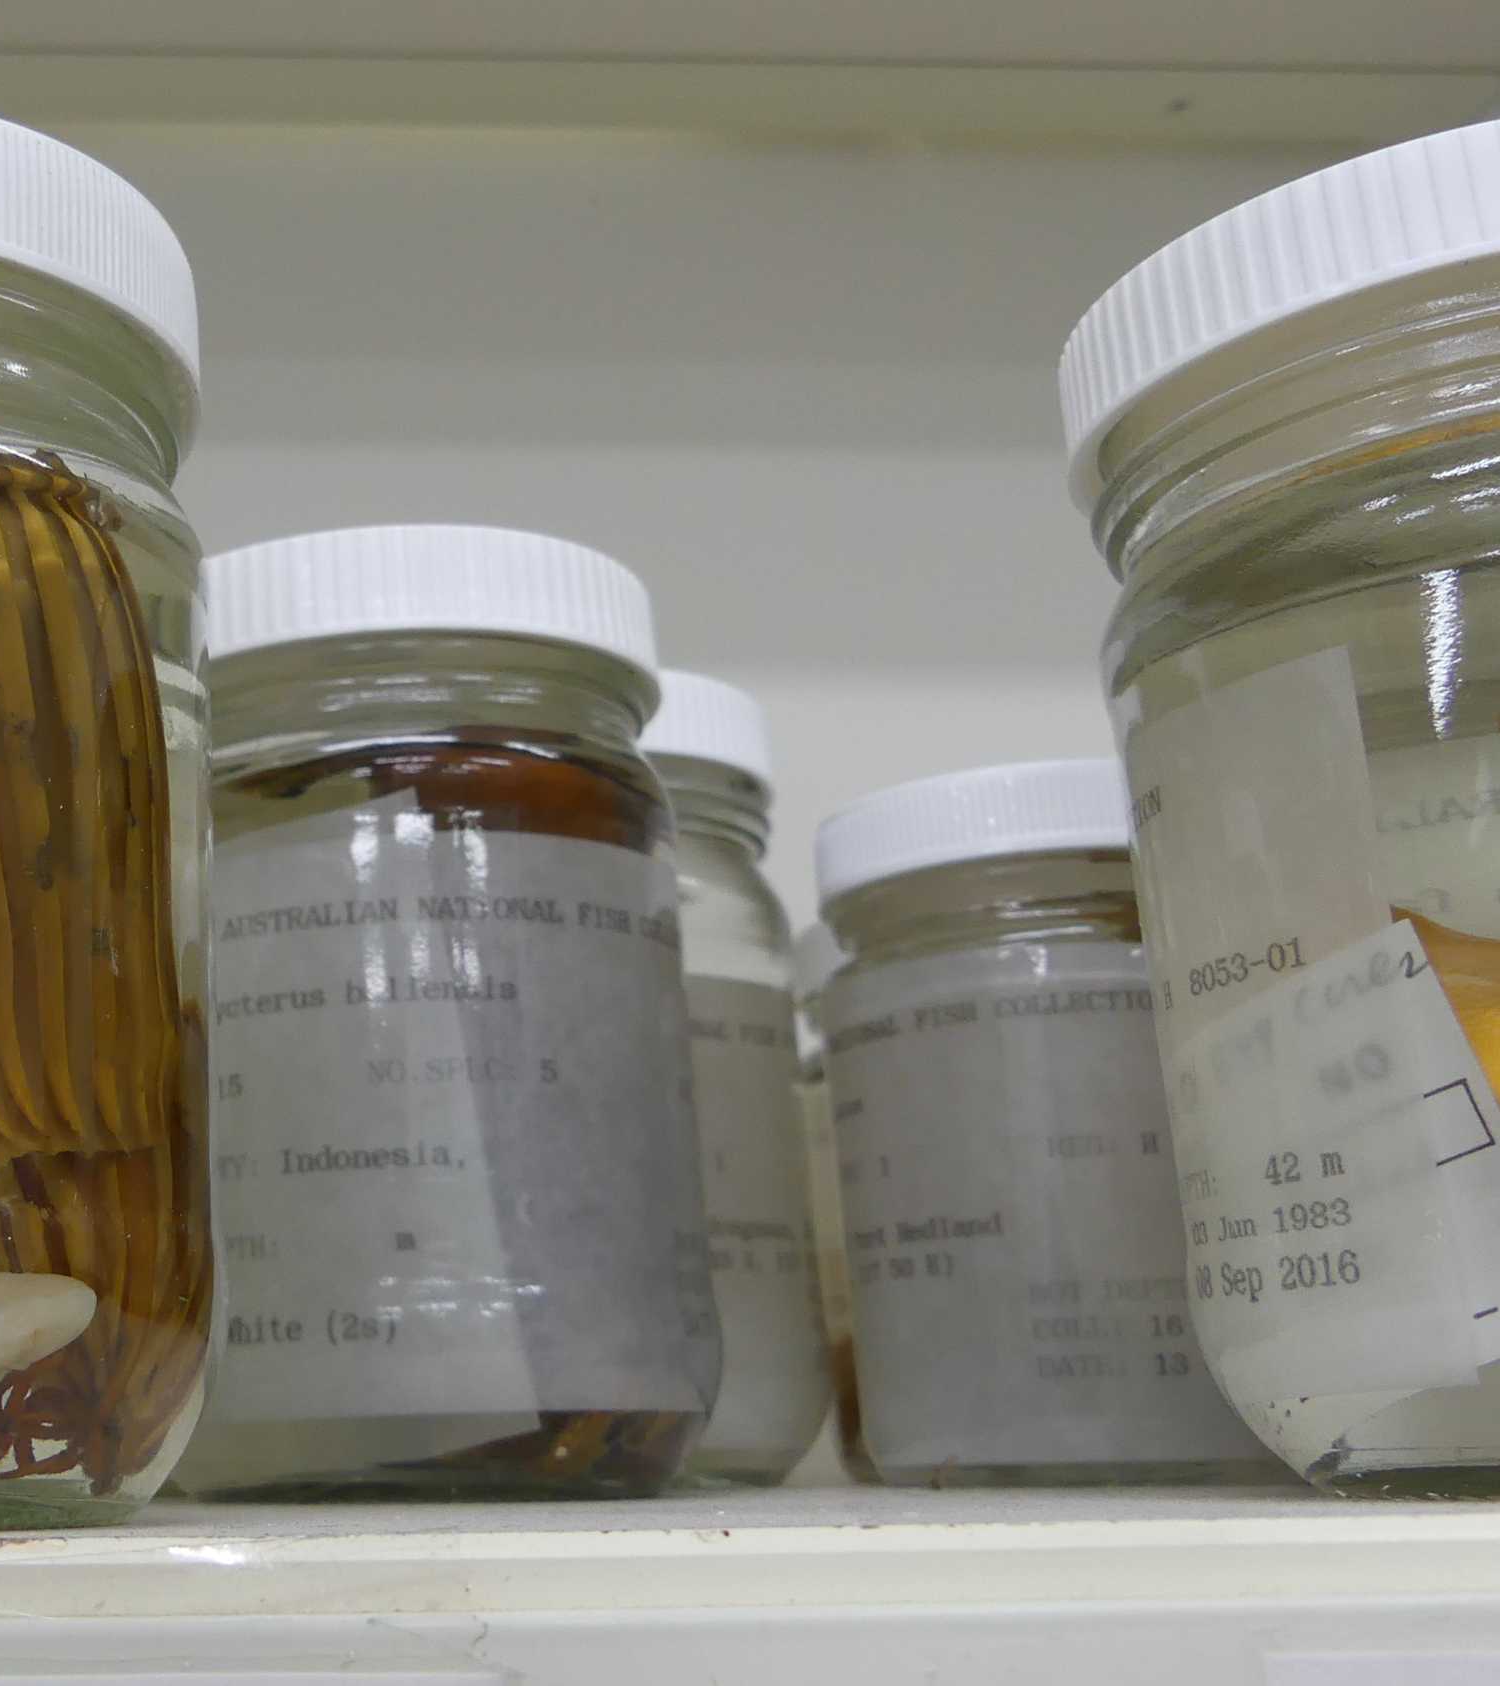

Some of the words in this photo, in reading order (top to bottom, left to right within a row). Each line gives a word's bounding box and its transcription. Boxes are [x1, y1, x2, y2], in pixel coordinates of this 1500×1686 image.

[220, 899, 398, 942] AUSTRALIAN
[1189, 937, 1307, 998] 8053-01
[539, 1058, 559, 1084] 5
[279, 1140, 466, 1176] Indonesia,
[1264, 1151, 1302, 1186] 42
[1320, 1151, 1346, 1178] m
[1217, 1215, 1259, 1242] Jun
[1273, 1197, 1353, 1234] 1983
[1220, 1261, 1264, 1303] Sep
[1279, 1249, 1361, 1291] 2016
[327, 1309, 397, 1347] (2s)
